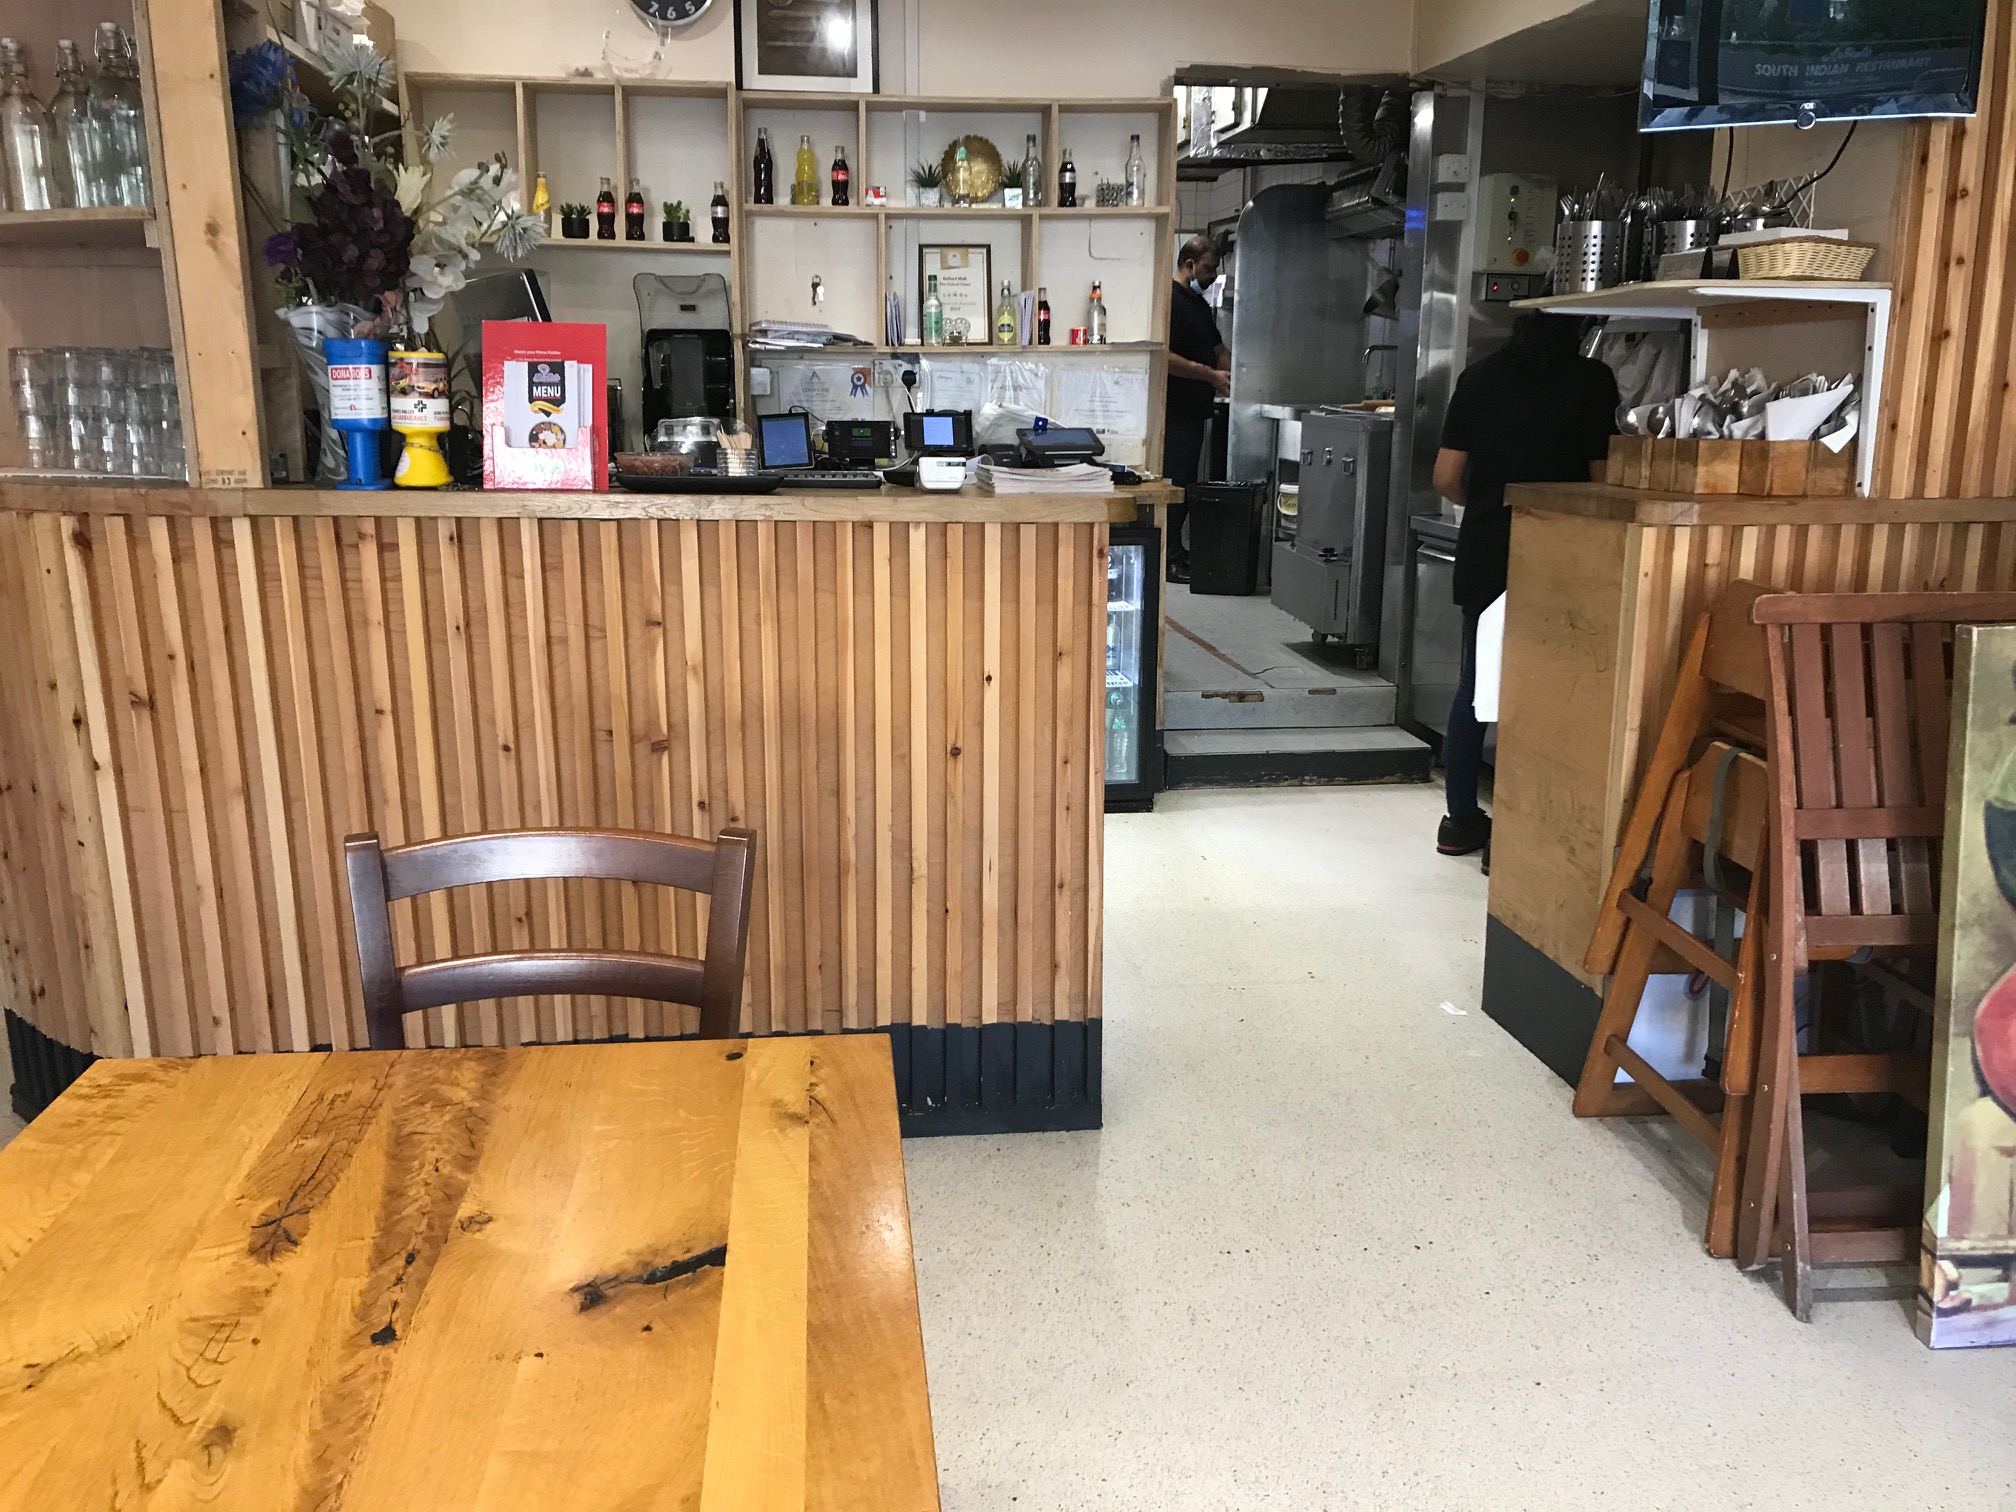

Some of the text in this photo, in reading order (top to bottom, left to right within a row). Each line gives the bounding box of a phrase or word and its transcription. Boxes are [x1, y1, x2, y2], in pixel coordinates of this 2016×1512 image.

[648, 1, 659, 14] 7
[666, 6, 677, 19] 6
[684, 1, 696, 15] 5
[1754, 56, 1932, 77] SOUTH INDIAN RESTAURANT
[532, 385, 561, 397] MENU
